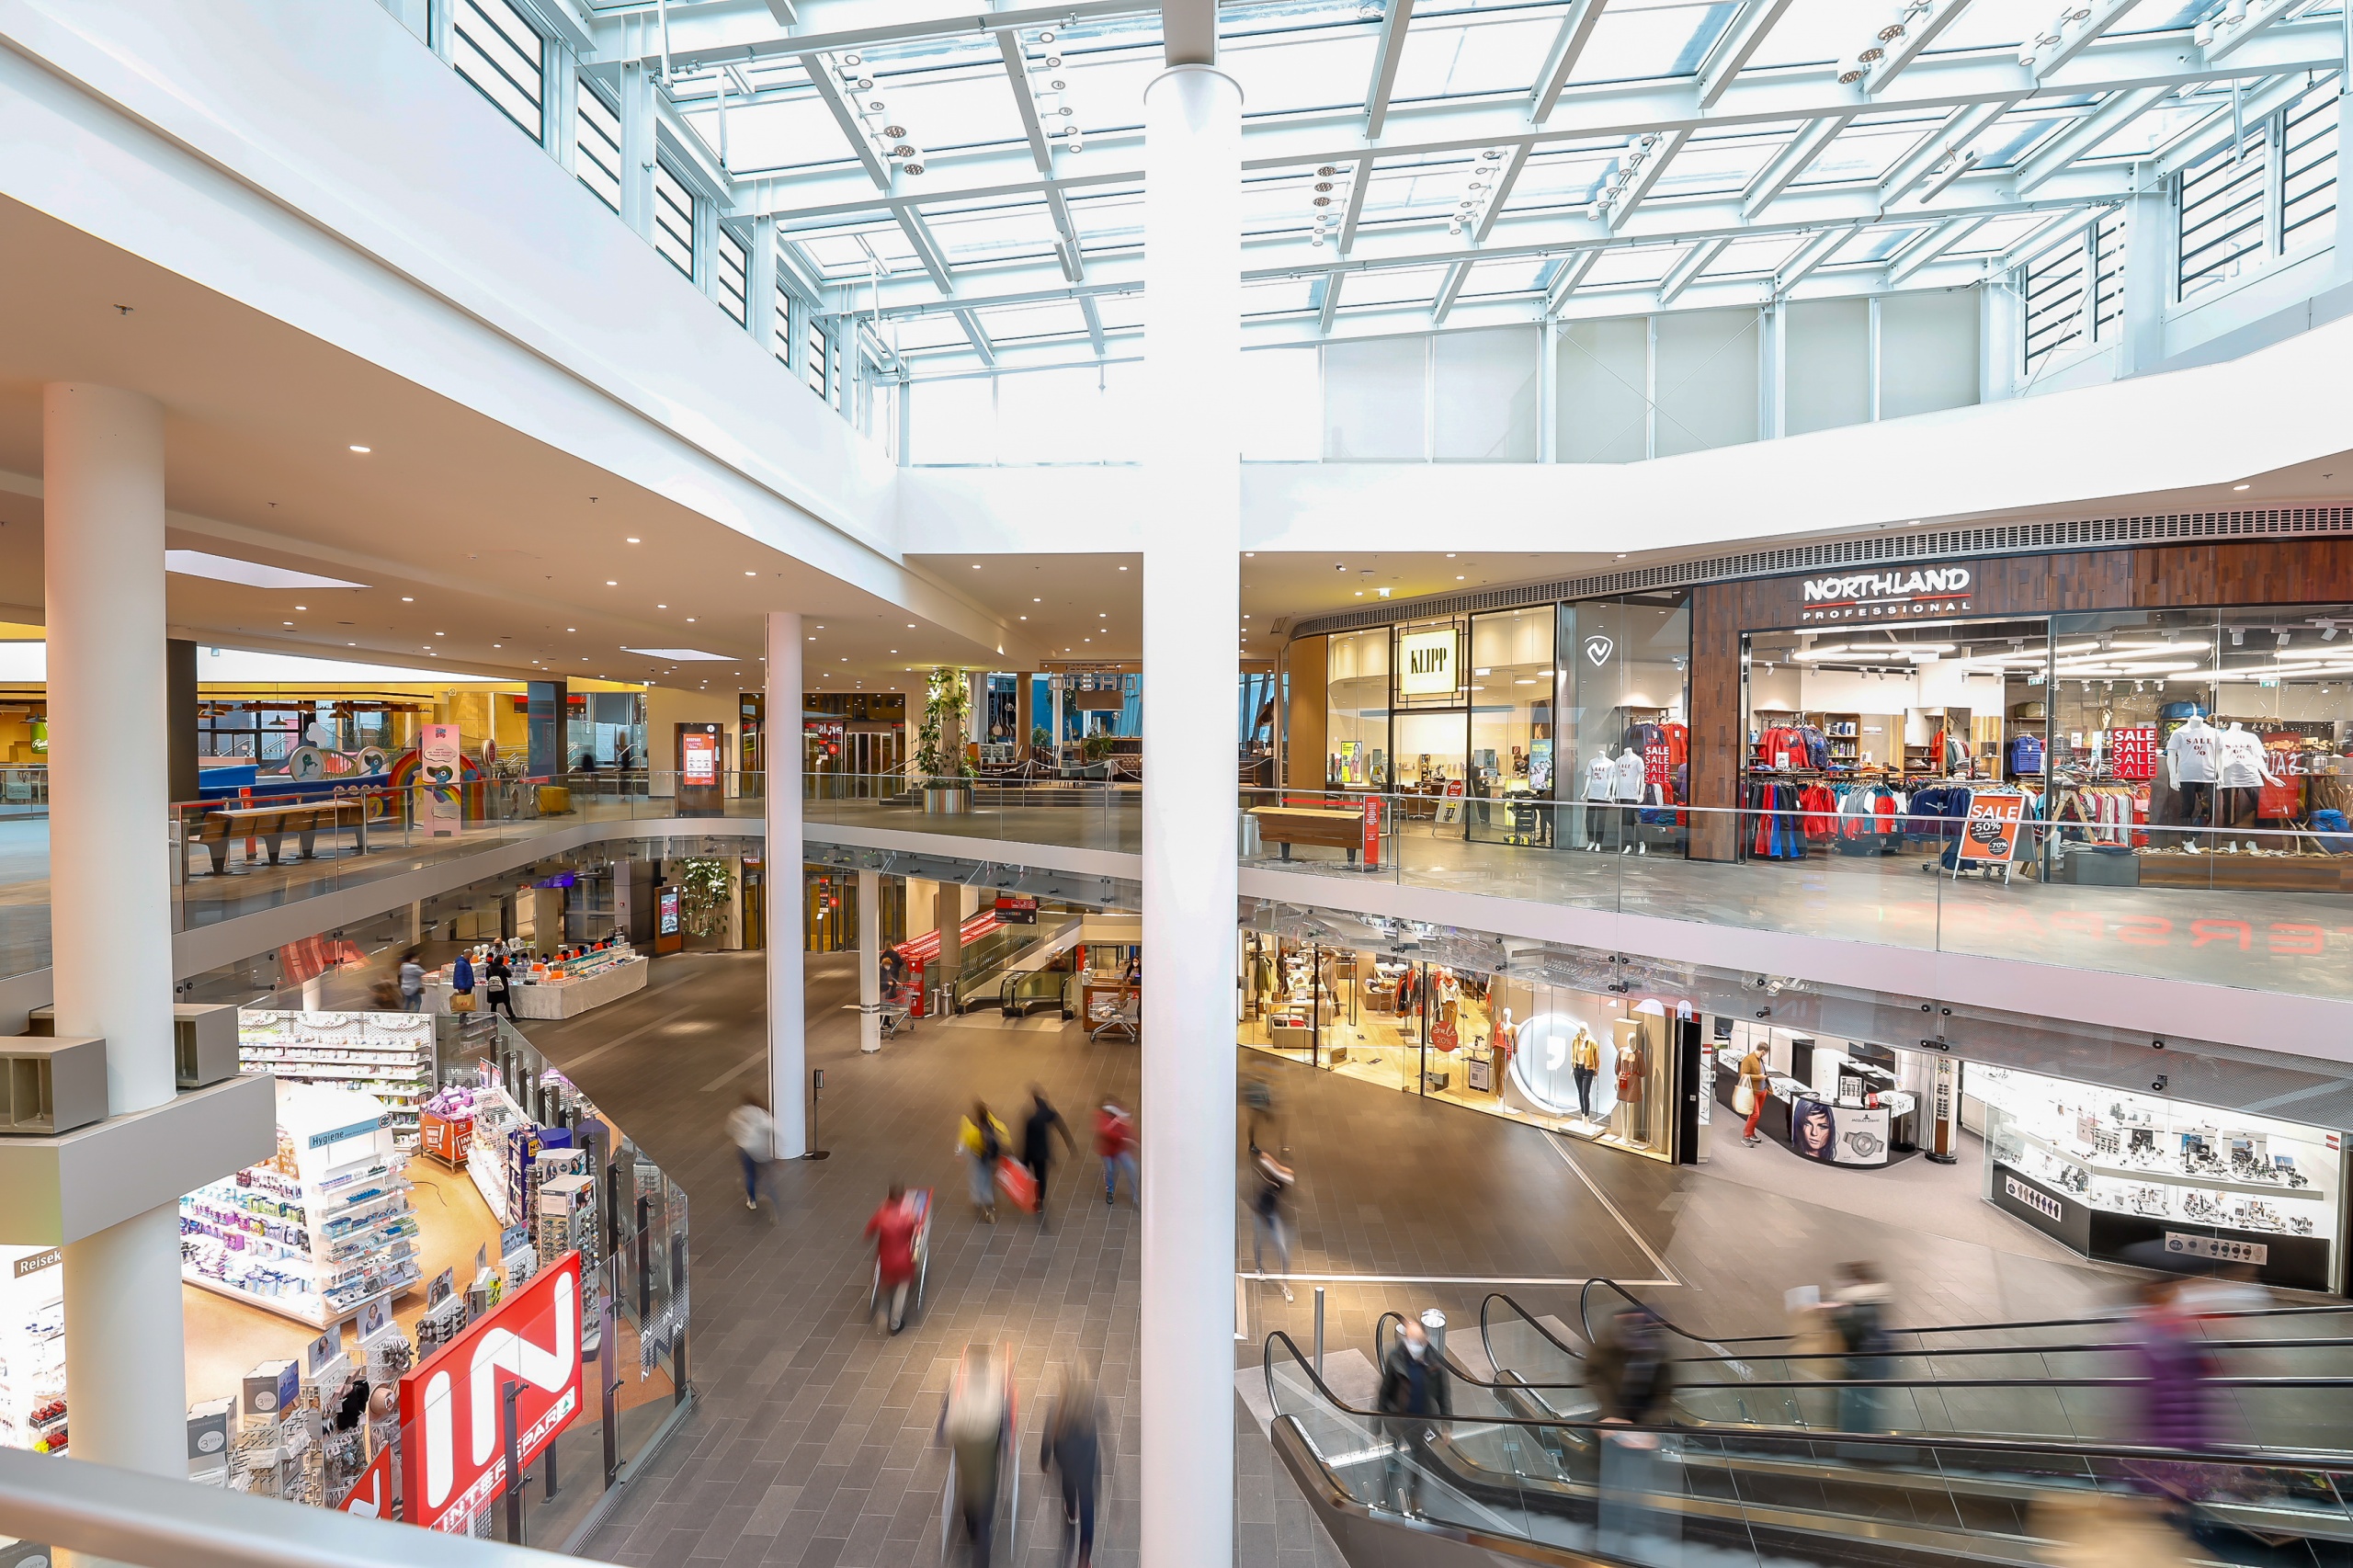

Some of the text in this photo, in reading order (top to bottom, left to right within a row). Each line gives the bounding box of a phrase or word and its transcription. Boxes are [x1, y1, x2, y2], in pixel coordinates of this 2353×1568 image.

[1803, 568, 1971, 601] NORTHLAND
[1802, 602, 1972, 620] PROFESSIONAL
[1411, 647, 1448, 675] KLIPP
[2114, 730, 2155, 742] SALE
[1645, 746, 1670, 755] SALE
[2114, 742, 2155, 753] SALE
[1645, 756, 1670, 764] SALE
[2114, 753, 2155, 765] SALE
[1645, 765, 1670, 773] SALE
[2113, 765, 2155, 777] SALE
[1644, 774, 1670, 783] SALE
[1971, 805, 2019, 820] SALE
[1971, 822, 2002, 833] -50%
[1432, 1022, 1457, 1038] Sale
[1437, 1036, 1452, 1046] 20%
[313, 1131, 345, 1147] Hygiene
[424, 1272, 575, 1509] IN
